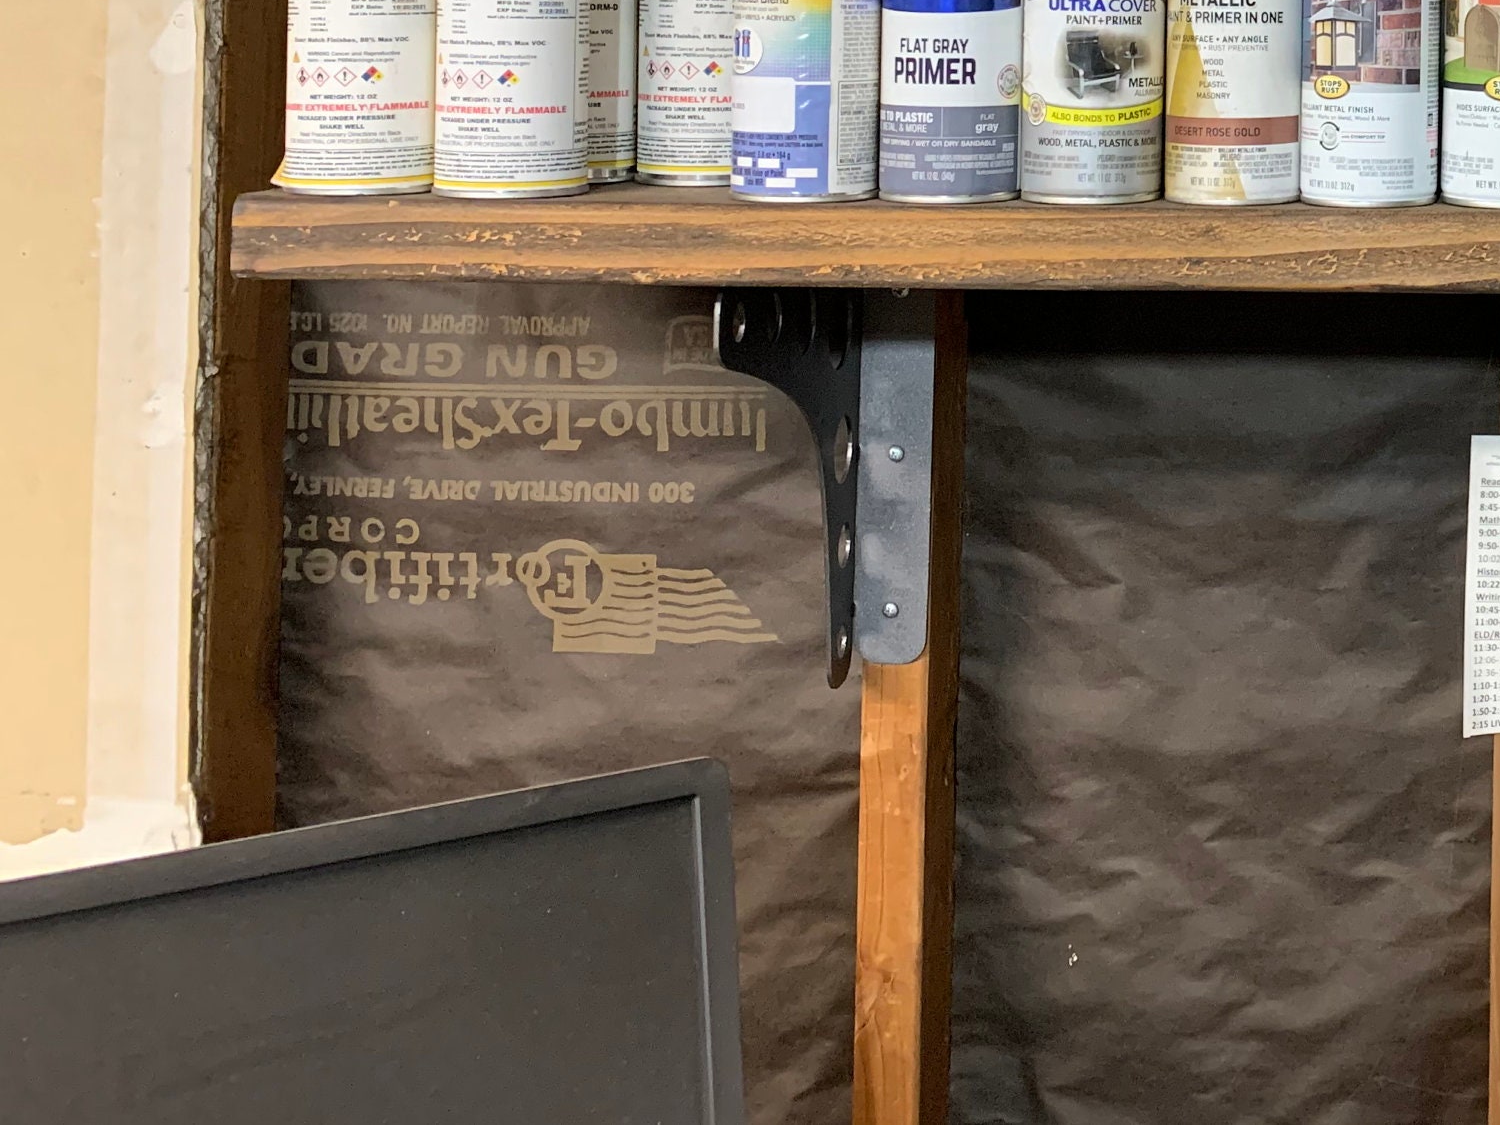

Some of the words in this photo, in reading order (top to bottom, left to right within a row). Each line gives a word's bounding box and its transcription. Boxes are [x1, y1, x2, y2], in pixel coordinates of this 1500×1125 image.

[1108, 0, 1156, 13] COVER
[1195, 12, 1242, 24] PRIMER
[1262, 12, 1283, 23] ONE
[901, 38, 929, 53] FLAT
[933, 39, 969, 53] GRAY
[895, 57, 976, 84] PRIMER
[370, 101, 429, 110] FLAMMABLE
[506, 106, 566, 114] FLAMMABLE
[1206, 128, 1230, 137] ROSE
[1234, 128, 1261, 137] GOLD
[291, 340, 463, 379] GRAD
[486, 343, 618, 380] GUN
[490, 480, 639, 503] INDUSTRIAL
[648, 481, 695, 504] 300
